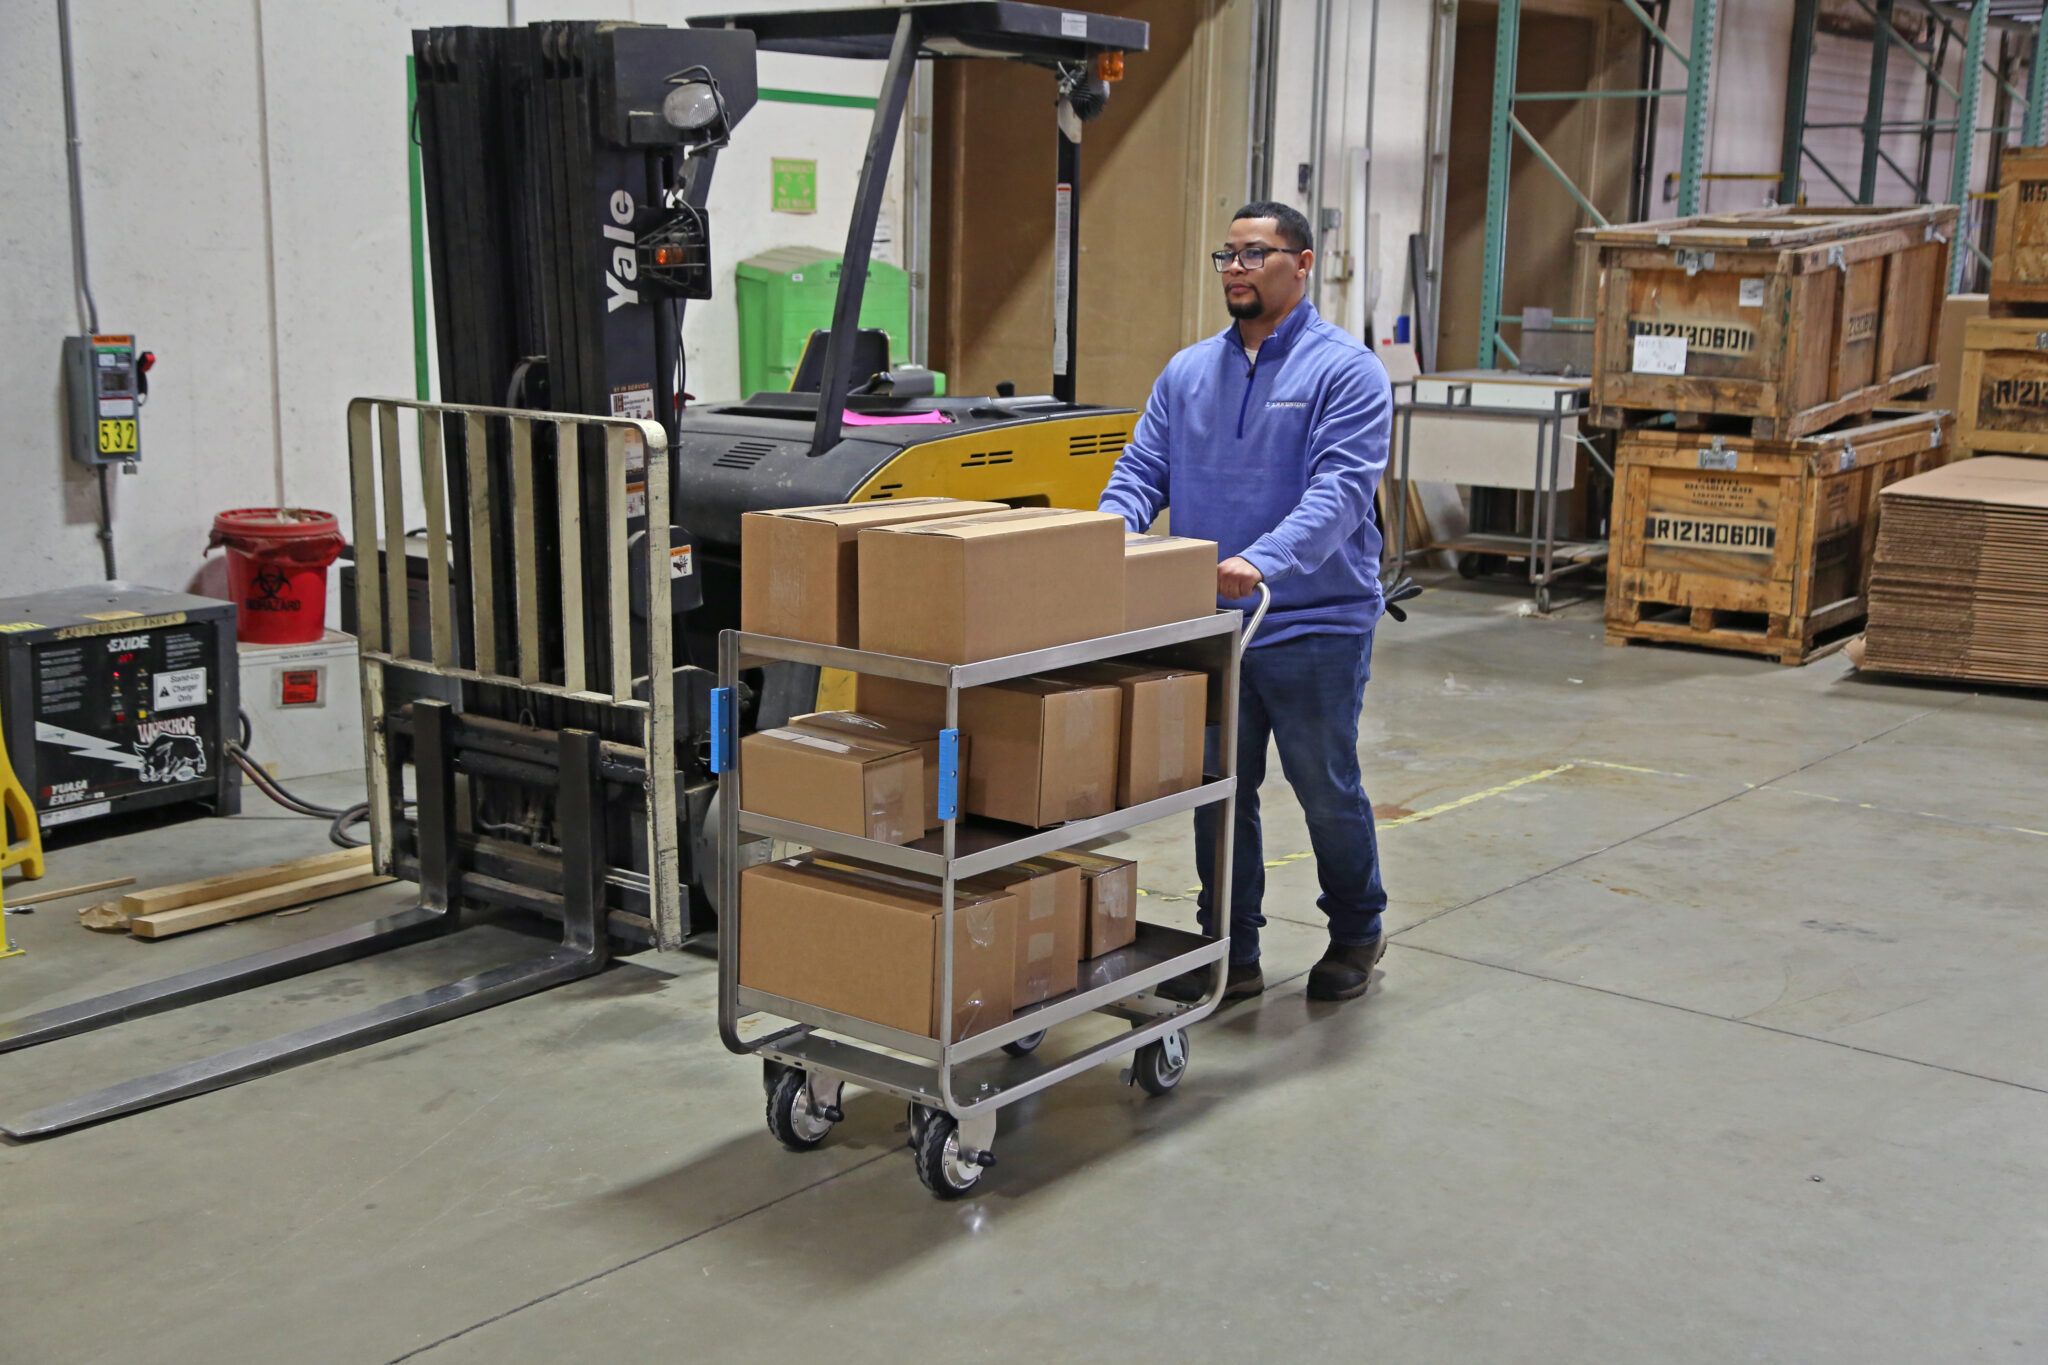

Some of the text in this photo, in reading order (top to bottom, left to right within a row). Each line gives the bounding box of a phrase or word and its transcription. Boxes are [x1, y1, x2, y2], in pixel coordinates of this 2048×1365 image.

[603, 189, 638, 313] Yale
[1638, 322, 1748, 351] R12130601
[101, 422, 135, 450] 532
[1658, 519, 1765, 546] R12130601
[107, 635, 150, 652] EXIDE
[137, 716, 196, 743] WORKHOG
[49, 791, 84, 806] EXIDE
[51, 780, 88, 795] YUASA
